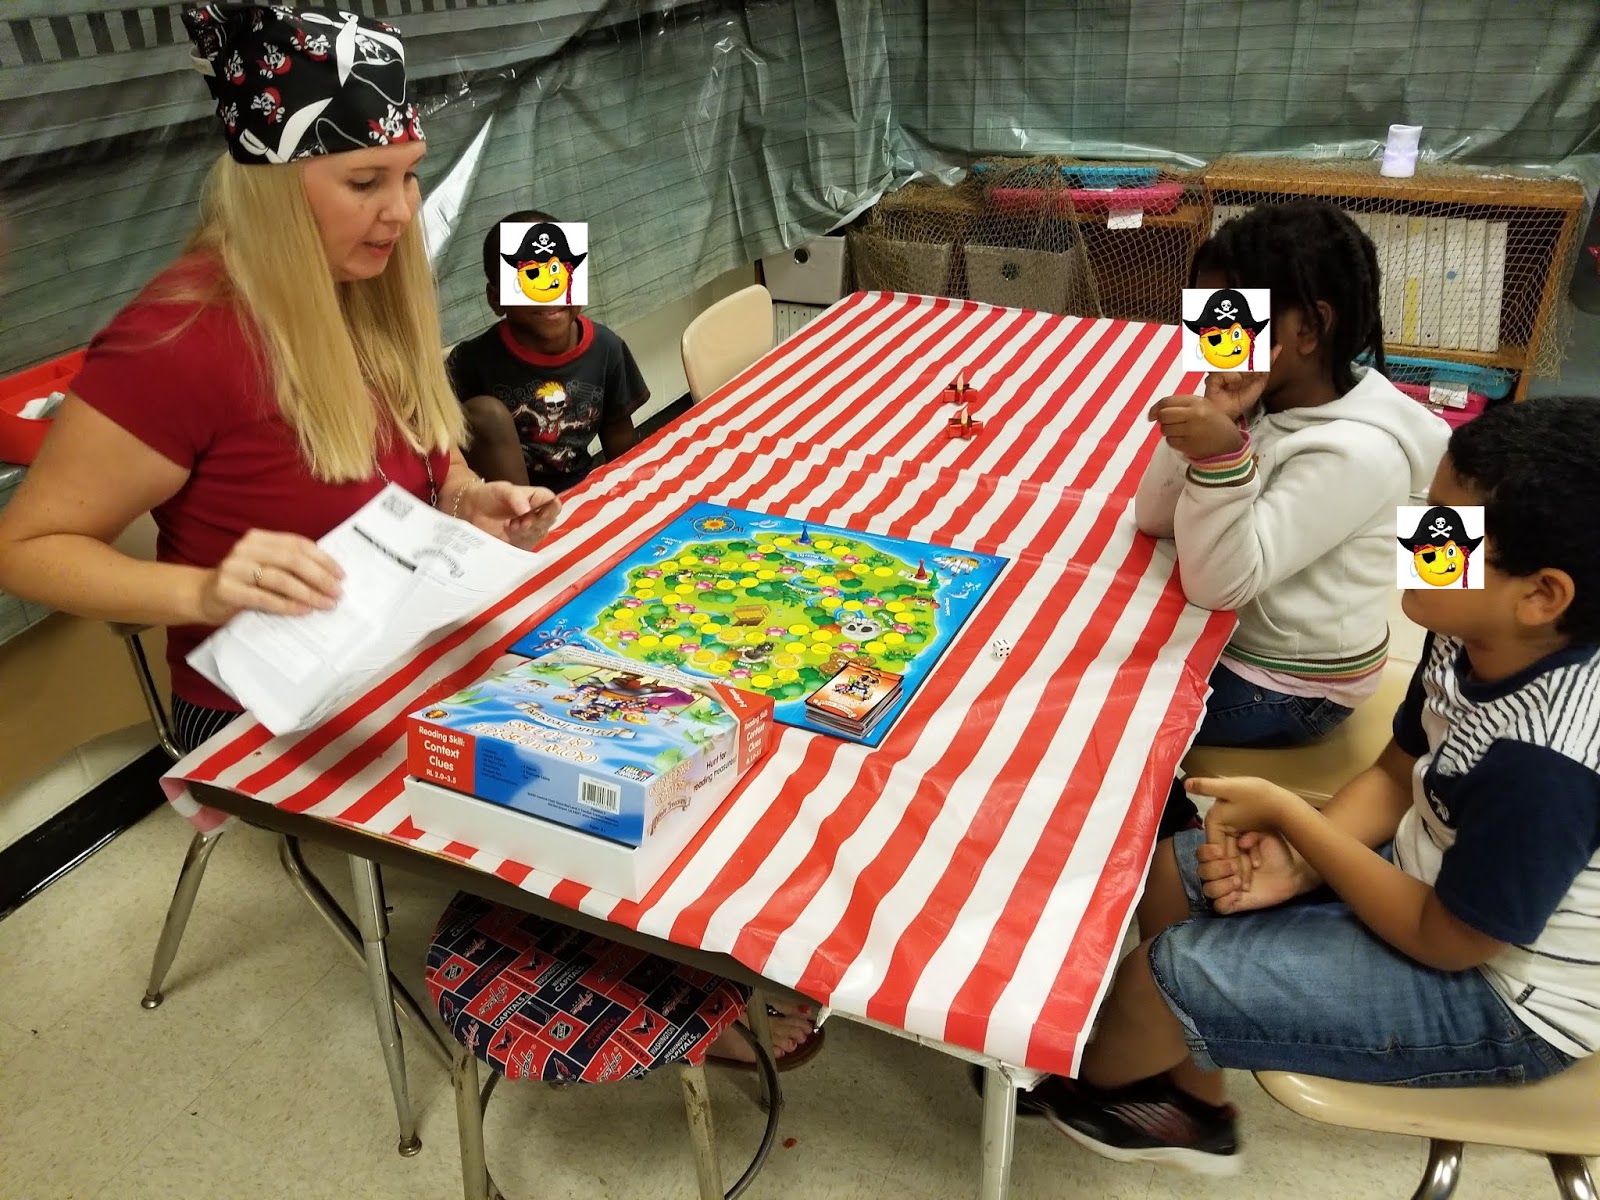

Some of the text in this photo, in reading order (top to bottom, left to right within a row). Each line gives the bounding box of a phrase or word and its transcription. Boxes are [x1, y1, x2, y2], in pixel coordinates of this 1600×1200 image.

[419, 726, 465, 747] Reading Skill:
[746, 721, 766, 742] Context
[424, 740, 460, 760] Context
[748, 738, 762, 753] Clues
[426, 769, 434, 777] RL
[429, 755, 454, 771] Clues
[706, 755, 719, 770] Hunt
[693, 774, 714, 793] reading
[554, 965, 585, 992] CAPITALS
[494, 996, 526, 1026] CAPITALS
[619, 1034, 649, 1062] CAPITALS
[649, 1025, 677, 1056] WASHINGTON
[663, 1030, 691, 1059] WASHINGTON
[665, 1033, 698, 1064] CAPITALS
